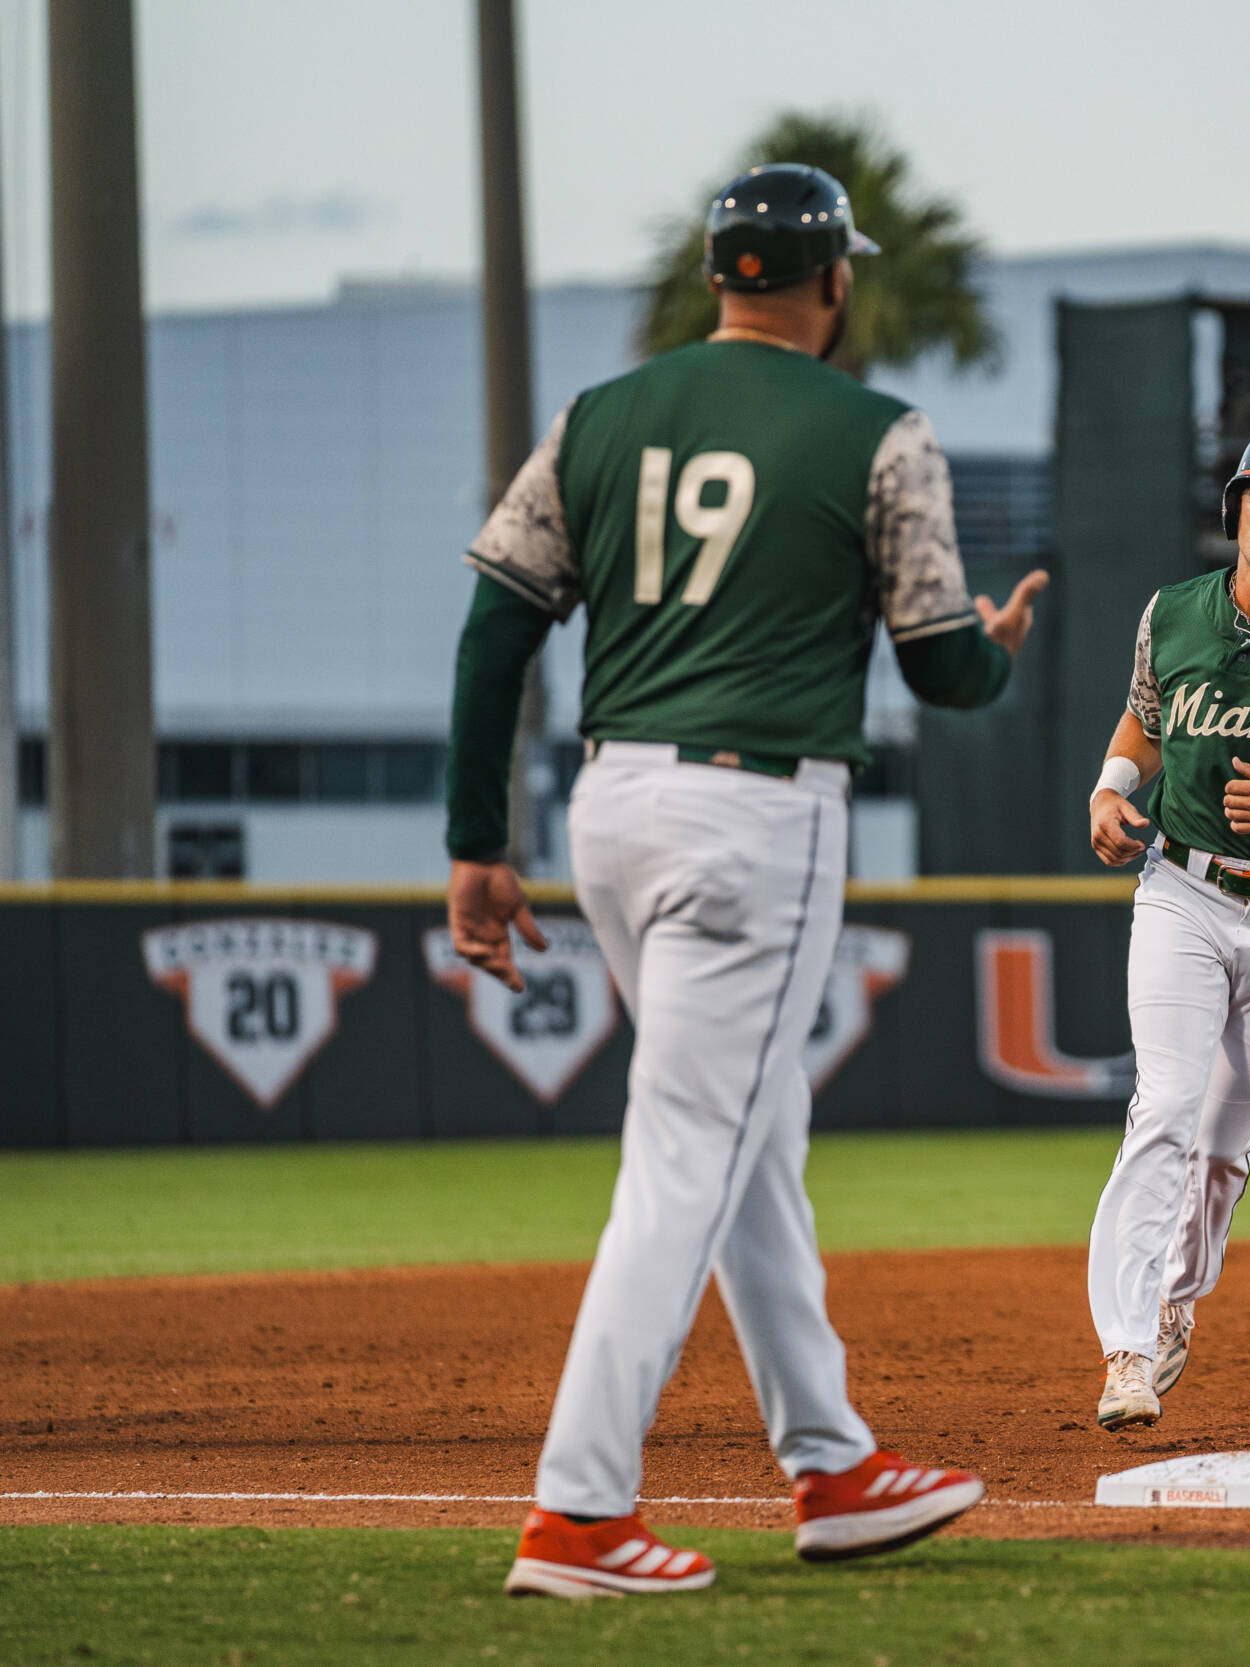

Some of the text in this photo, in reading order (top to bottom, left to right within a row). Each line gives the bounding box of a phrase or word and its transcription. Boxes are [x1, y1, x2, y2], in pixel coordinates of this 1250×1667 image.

[634, 447, 755, 606] 19
[227, 971, 298, 1040] 20
[1166, 1489, 1222, 1503] BASEBALL
